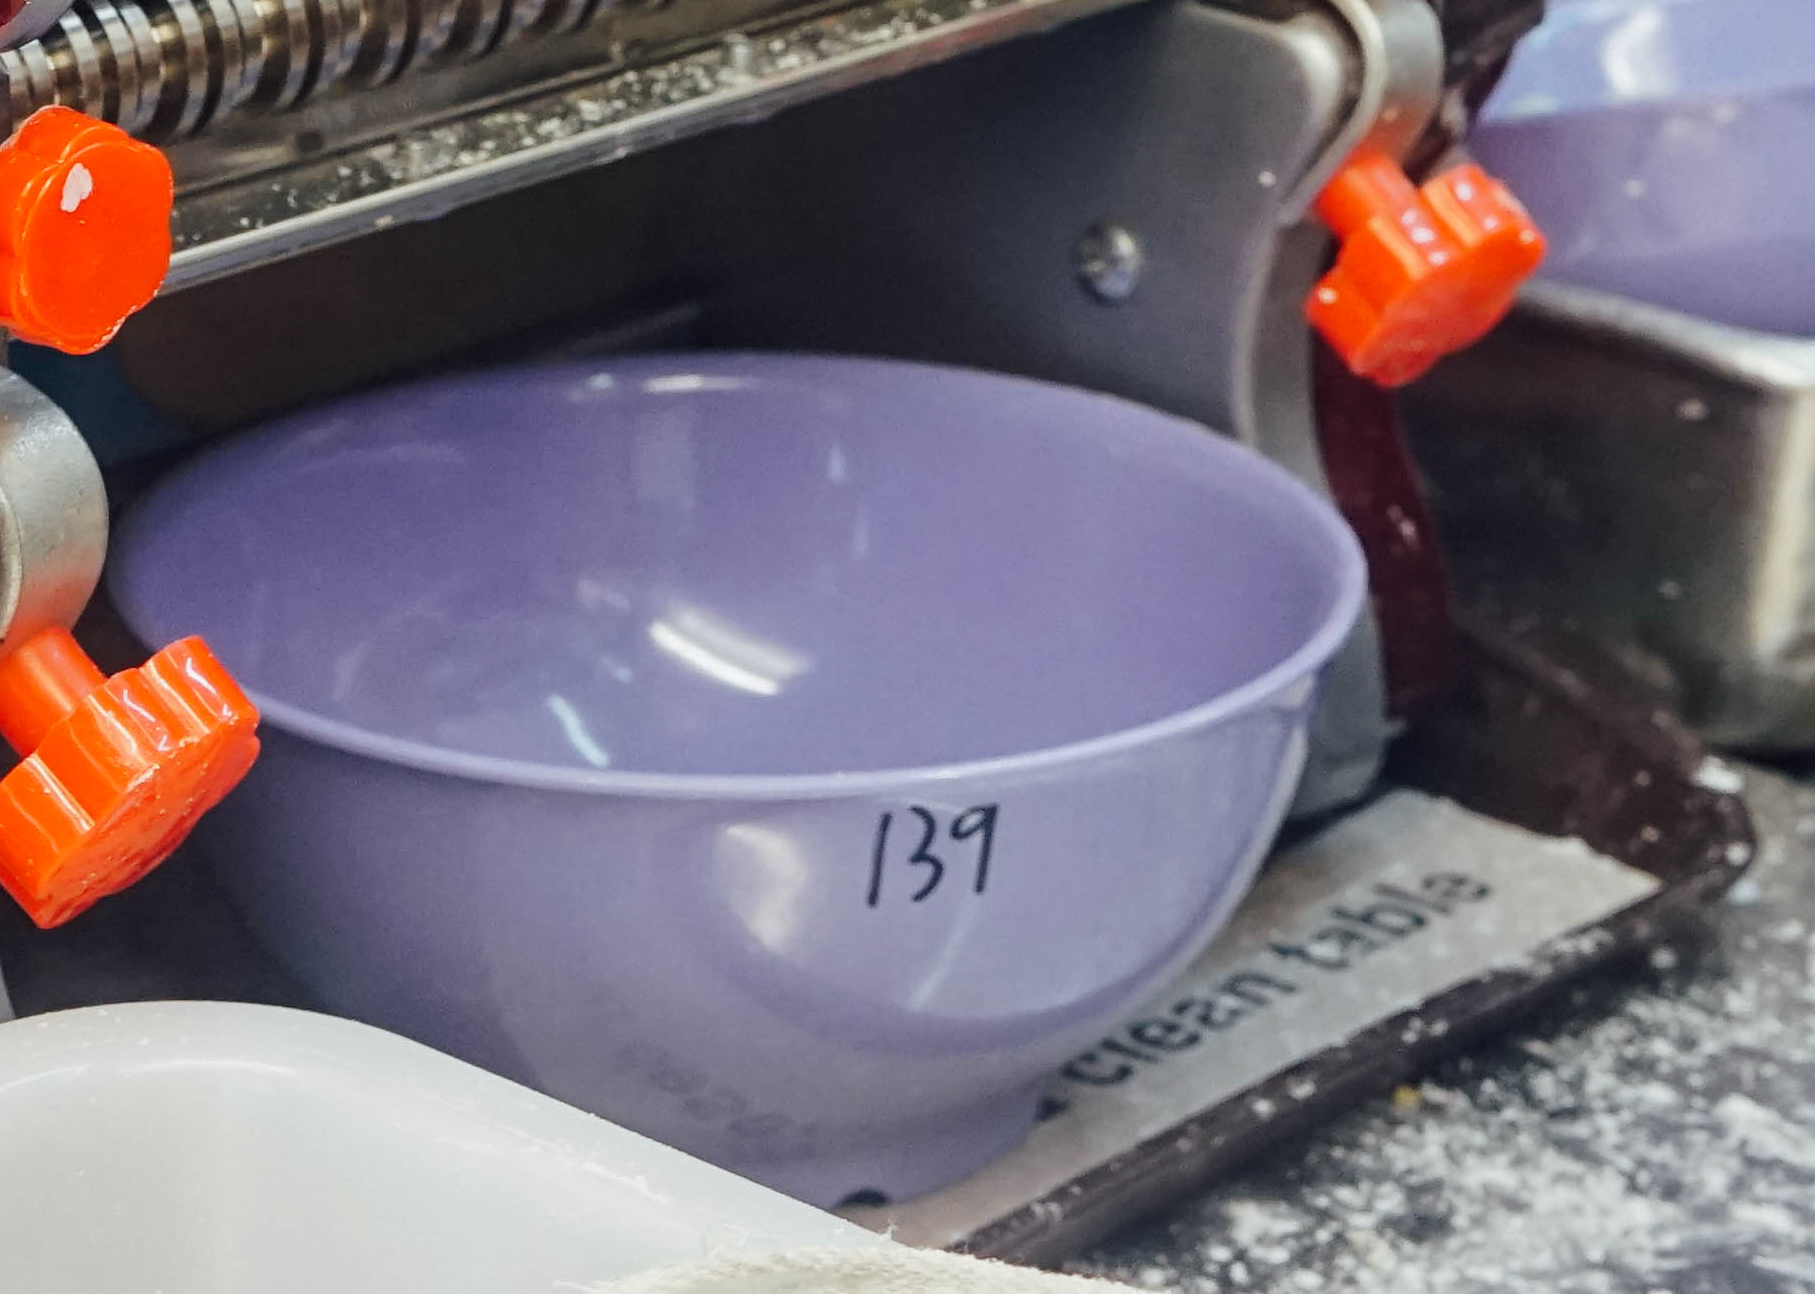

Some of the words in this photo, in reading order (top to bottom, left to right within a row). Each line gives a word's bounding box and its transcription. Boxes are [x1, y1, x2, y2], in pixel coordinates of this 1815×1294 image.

[867, 803, 1000, 908] 139
[1062, 972, 1298, 1086] clean
[1269, 872, 1494, 970] table
